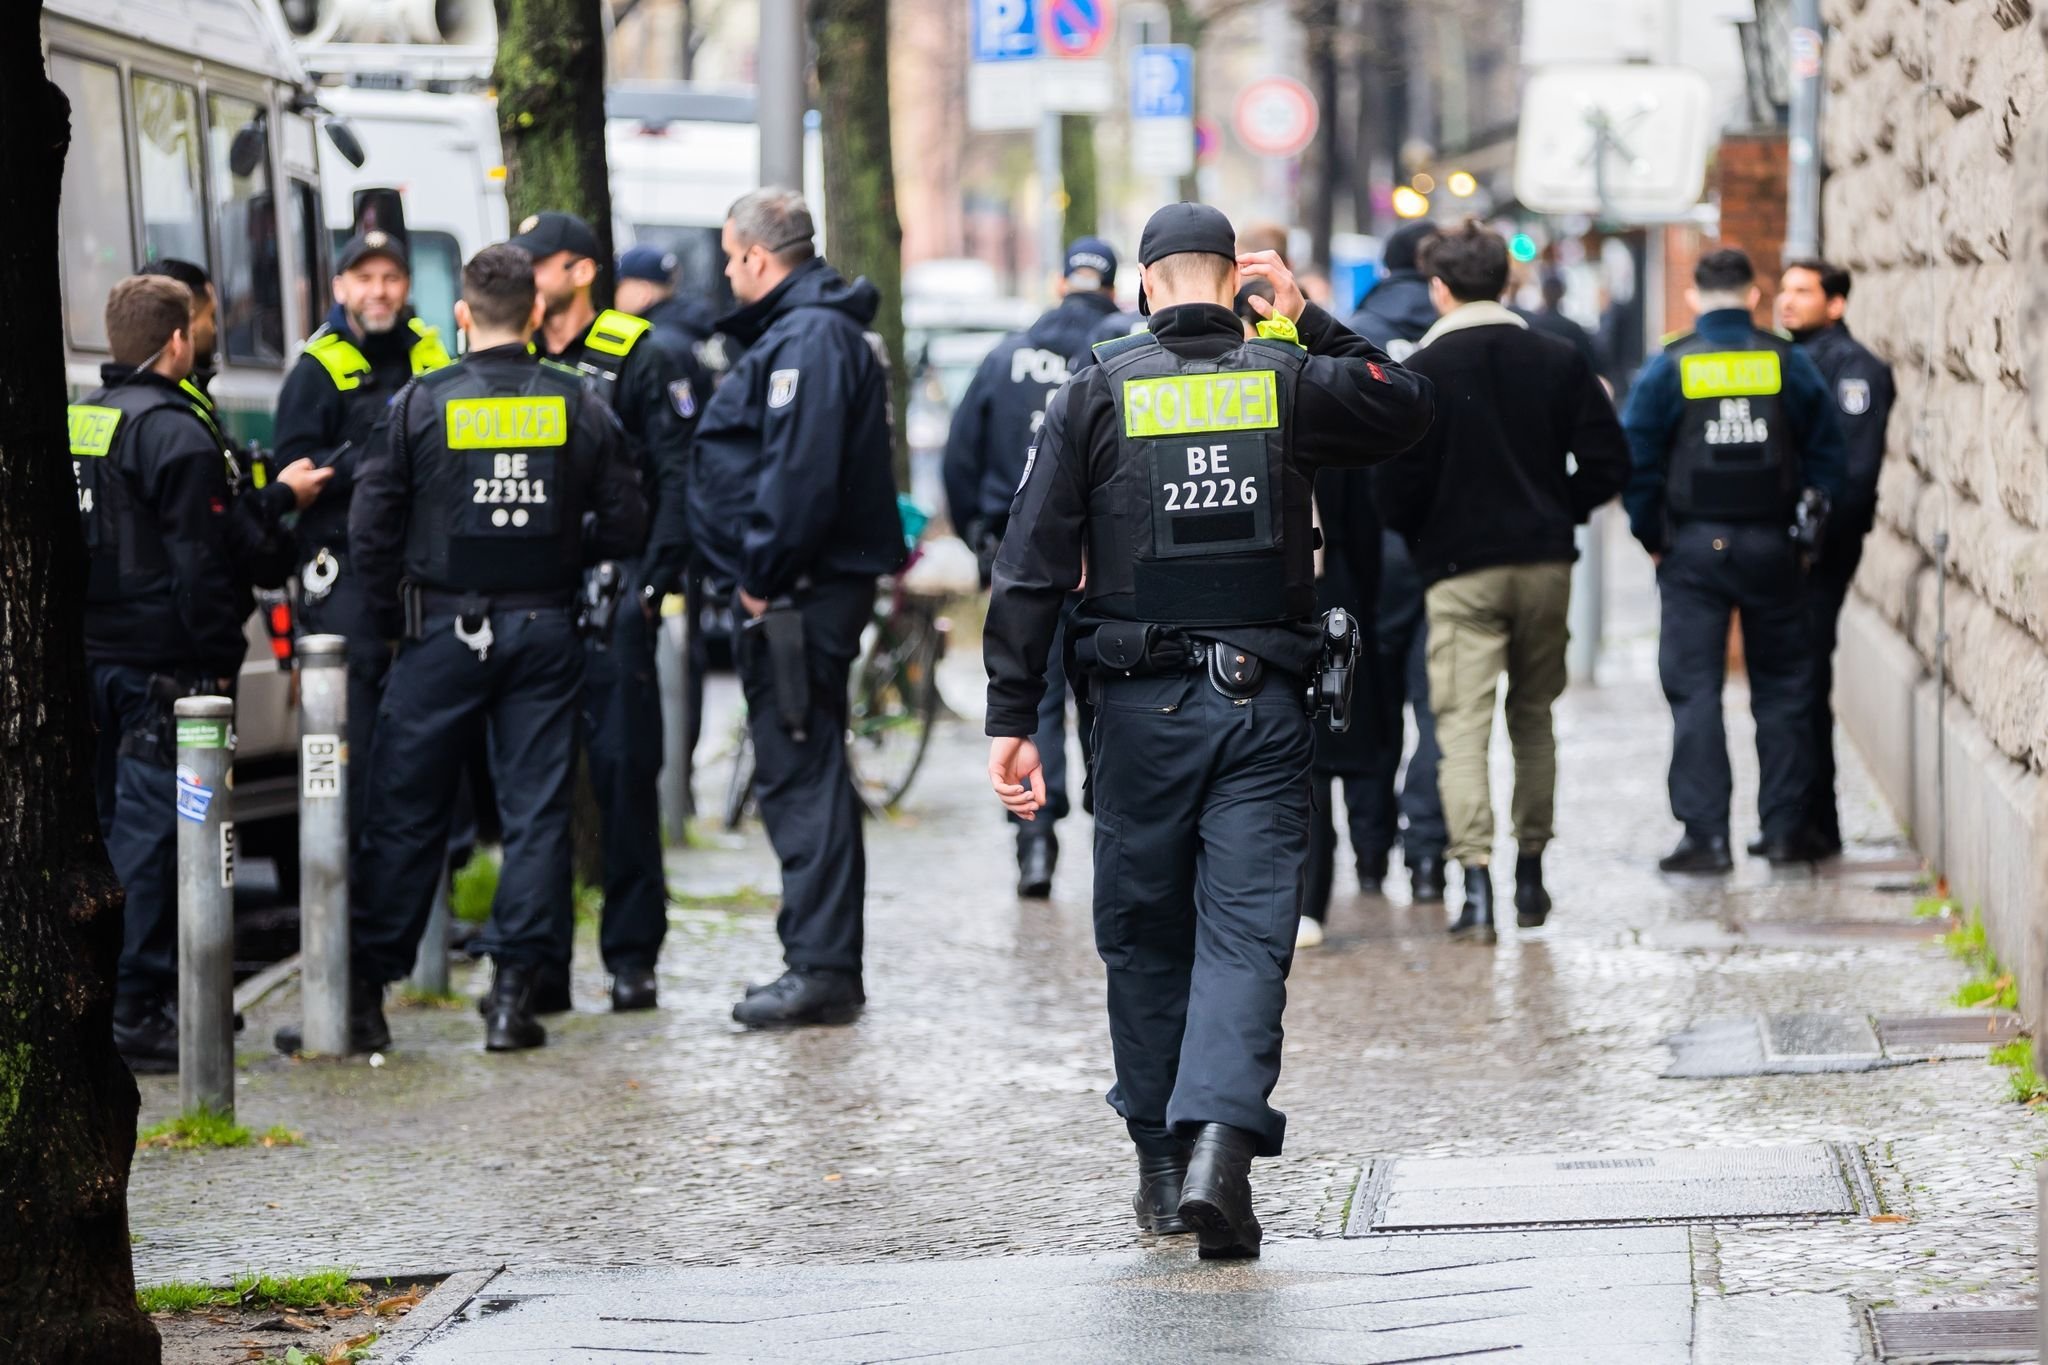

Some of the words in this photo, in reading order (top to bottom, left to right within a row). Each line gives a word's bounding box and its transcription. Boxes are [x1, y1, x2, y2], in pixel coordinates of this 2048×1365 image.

[1129, 375, 1274, 432] POLIZEI
[455, 405, 561, 441] POLIZEI
[493, 453, 528, 479] BE
[1186, 444, 1230, 476] BE
[472, 478, 548, 504] 22311
[1162, 476, 1258, 512] 22226
[309, 743, 335, 791] BNE
